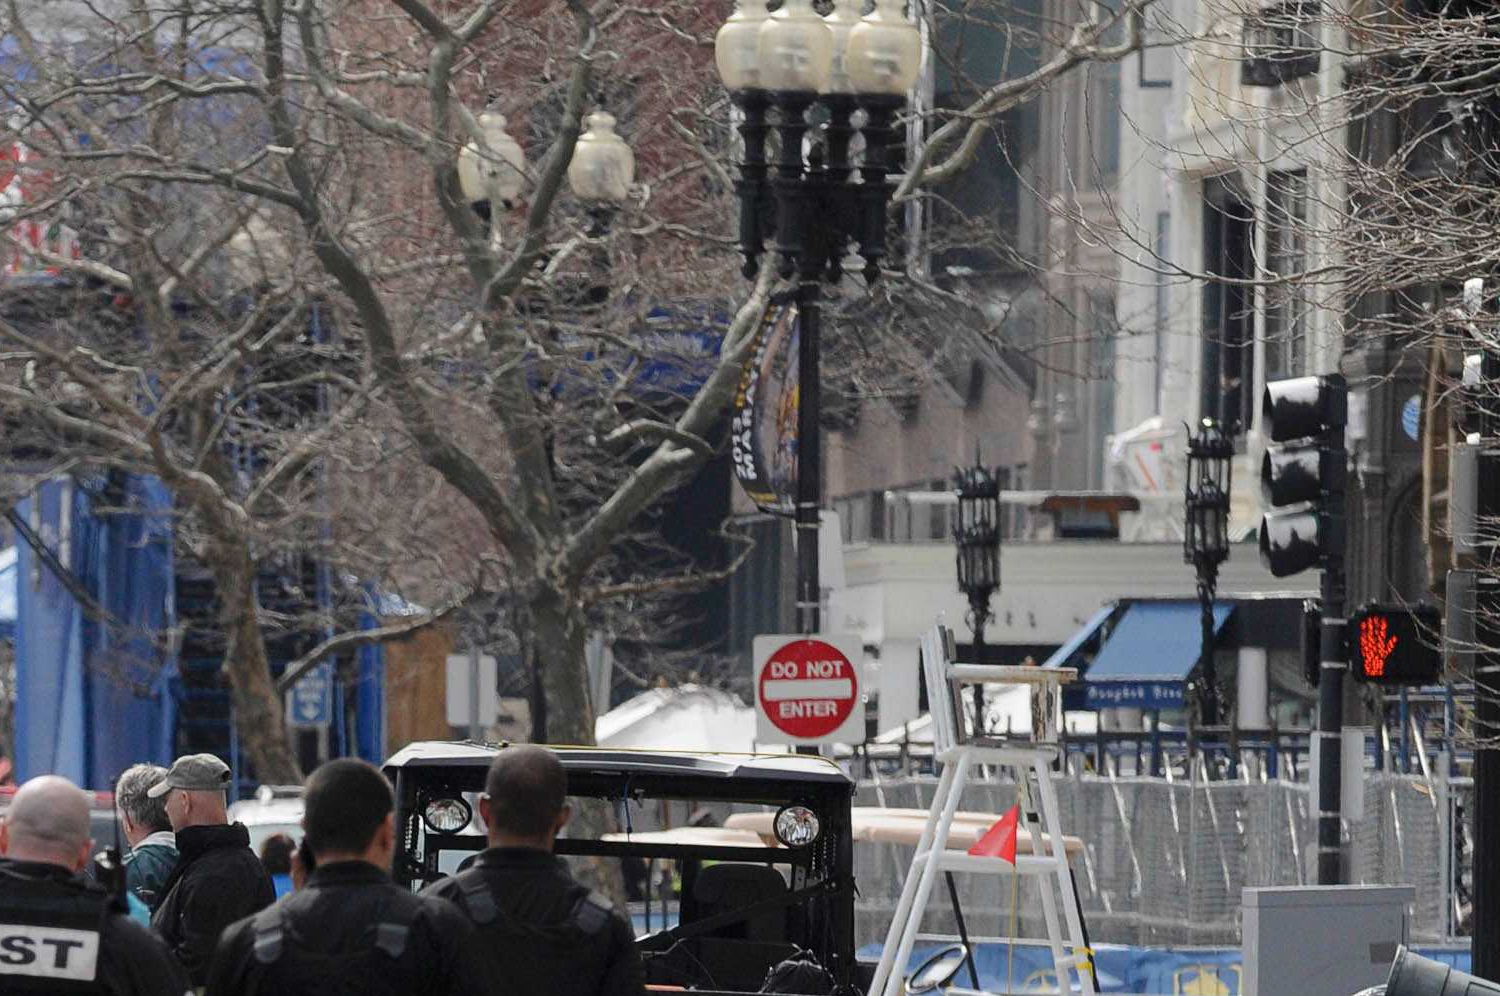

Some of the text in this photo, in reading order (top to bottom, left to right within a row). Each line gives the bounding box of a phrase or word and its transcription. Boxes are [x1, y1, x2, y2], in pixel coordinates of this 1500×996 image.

[732, 416, 748, 479] 2013
[771, 660, 844, 678] DO NOT
[780, 700, 838, 718] ENTER
